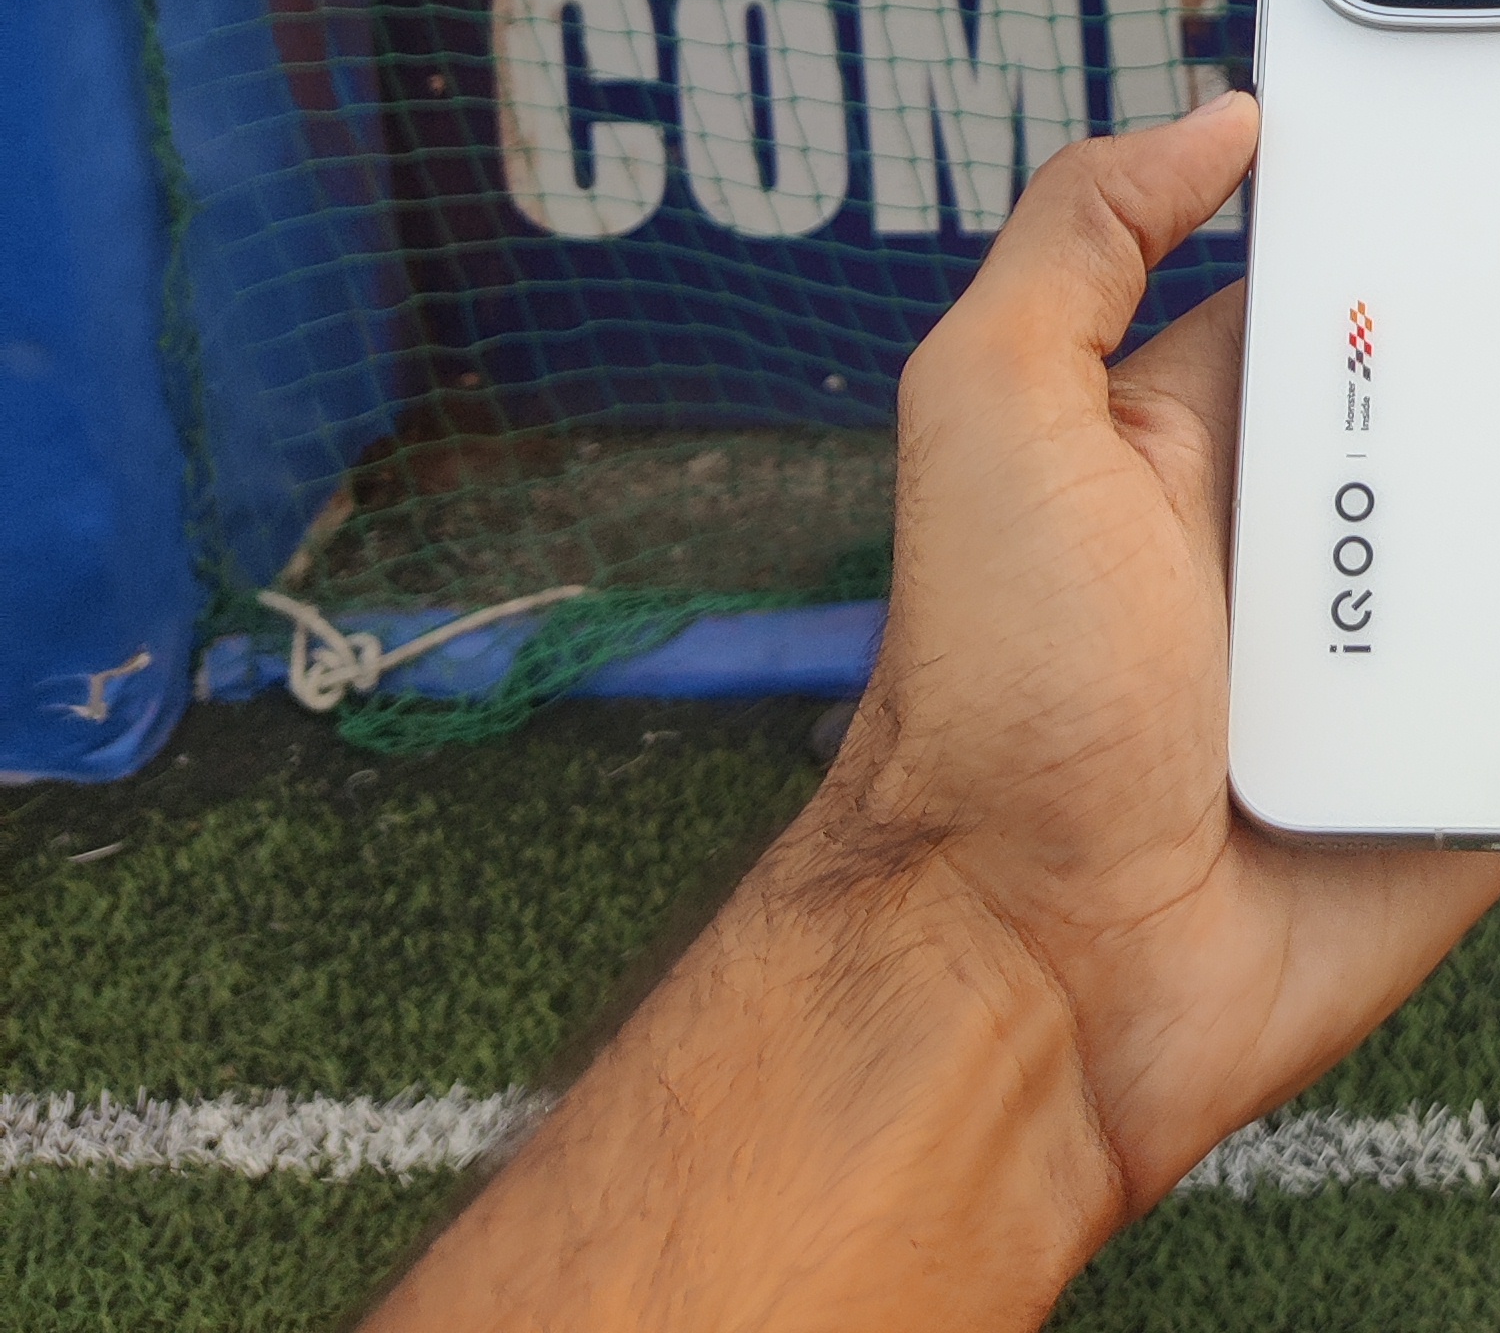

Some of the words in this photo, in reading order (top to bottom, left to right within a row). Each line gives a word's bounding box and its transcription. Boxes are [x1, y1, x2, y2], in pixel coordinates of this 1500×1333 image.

[1345, 380, 1356, 431] Monster
[1360, 395, 1371, 431] Inside
[1329, 481, 1376, 653] iQOO
